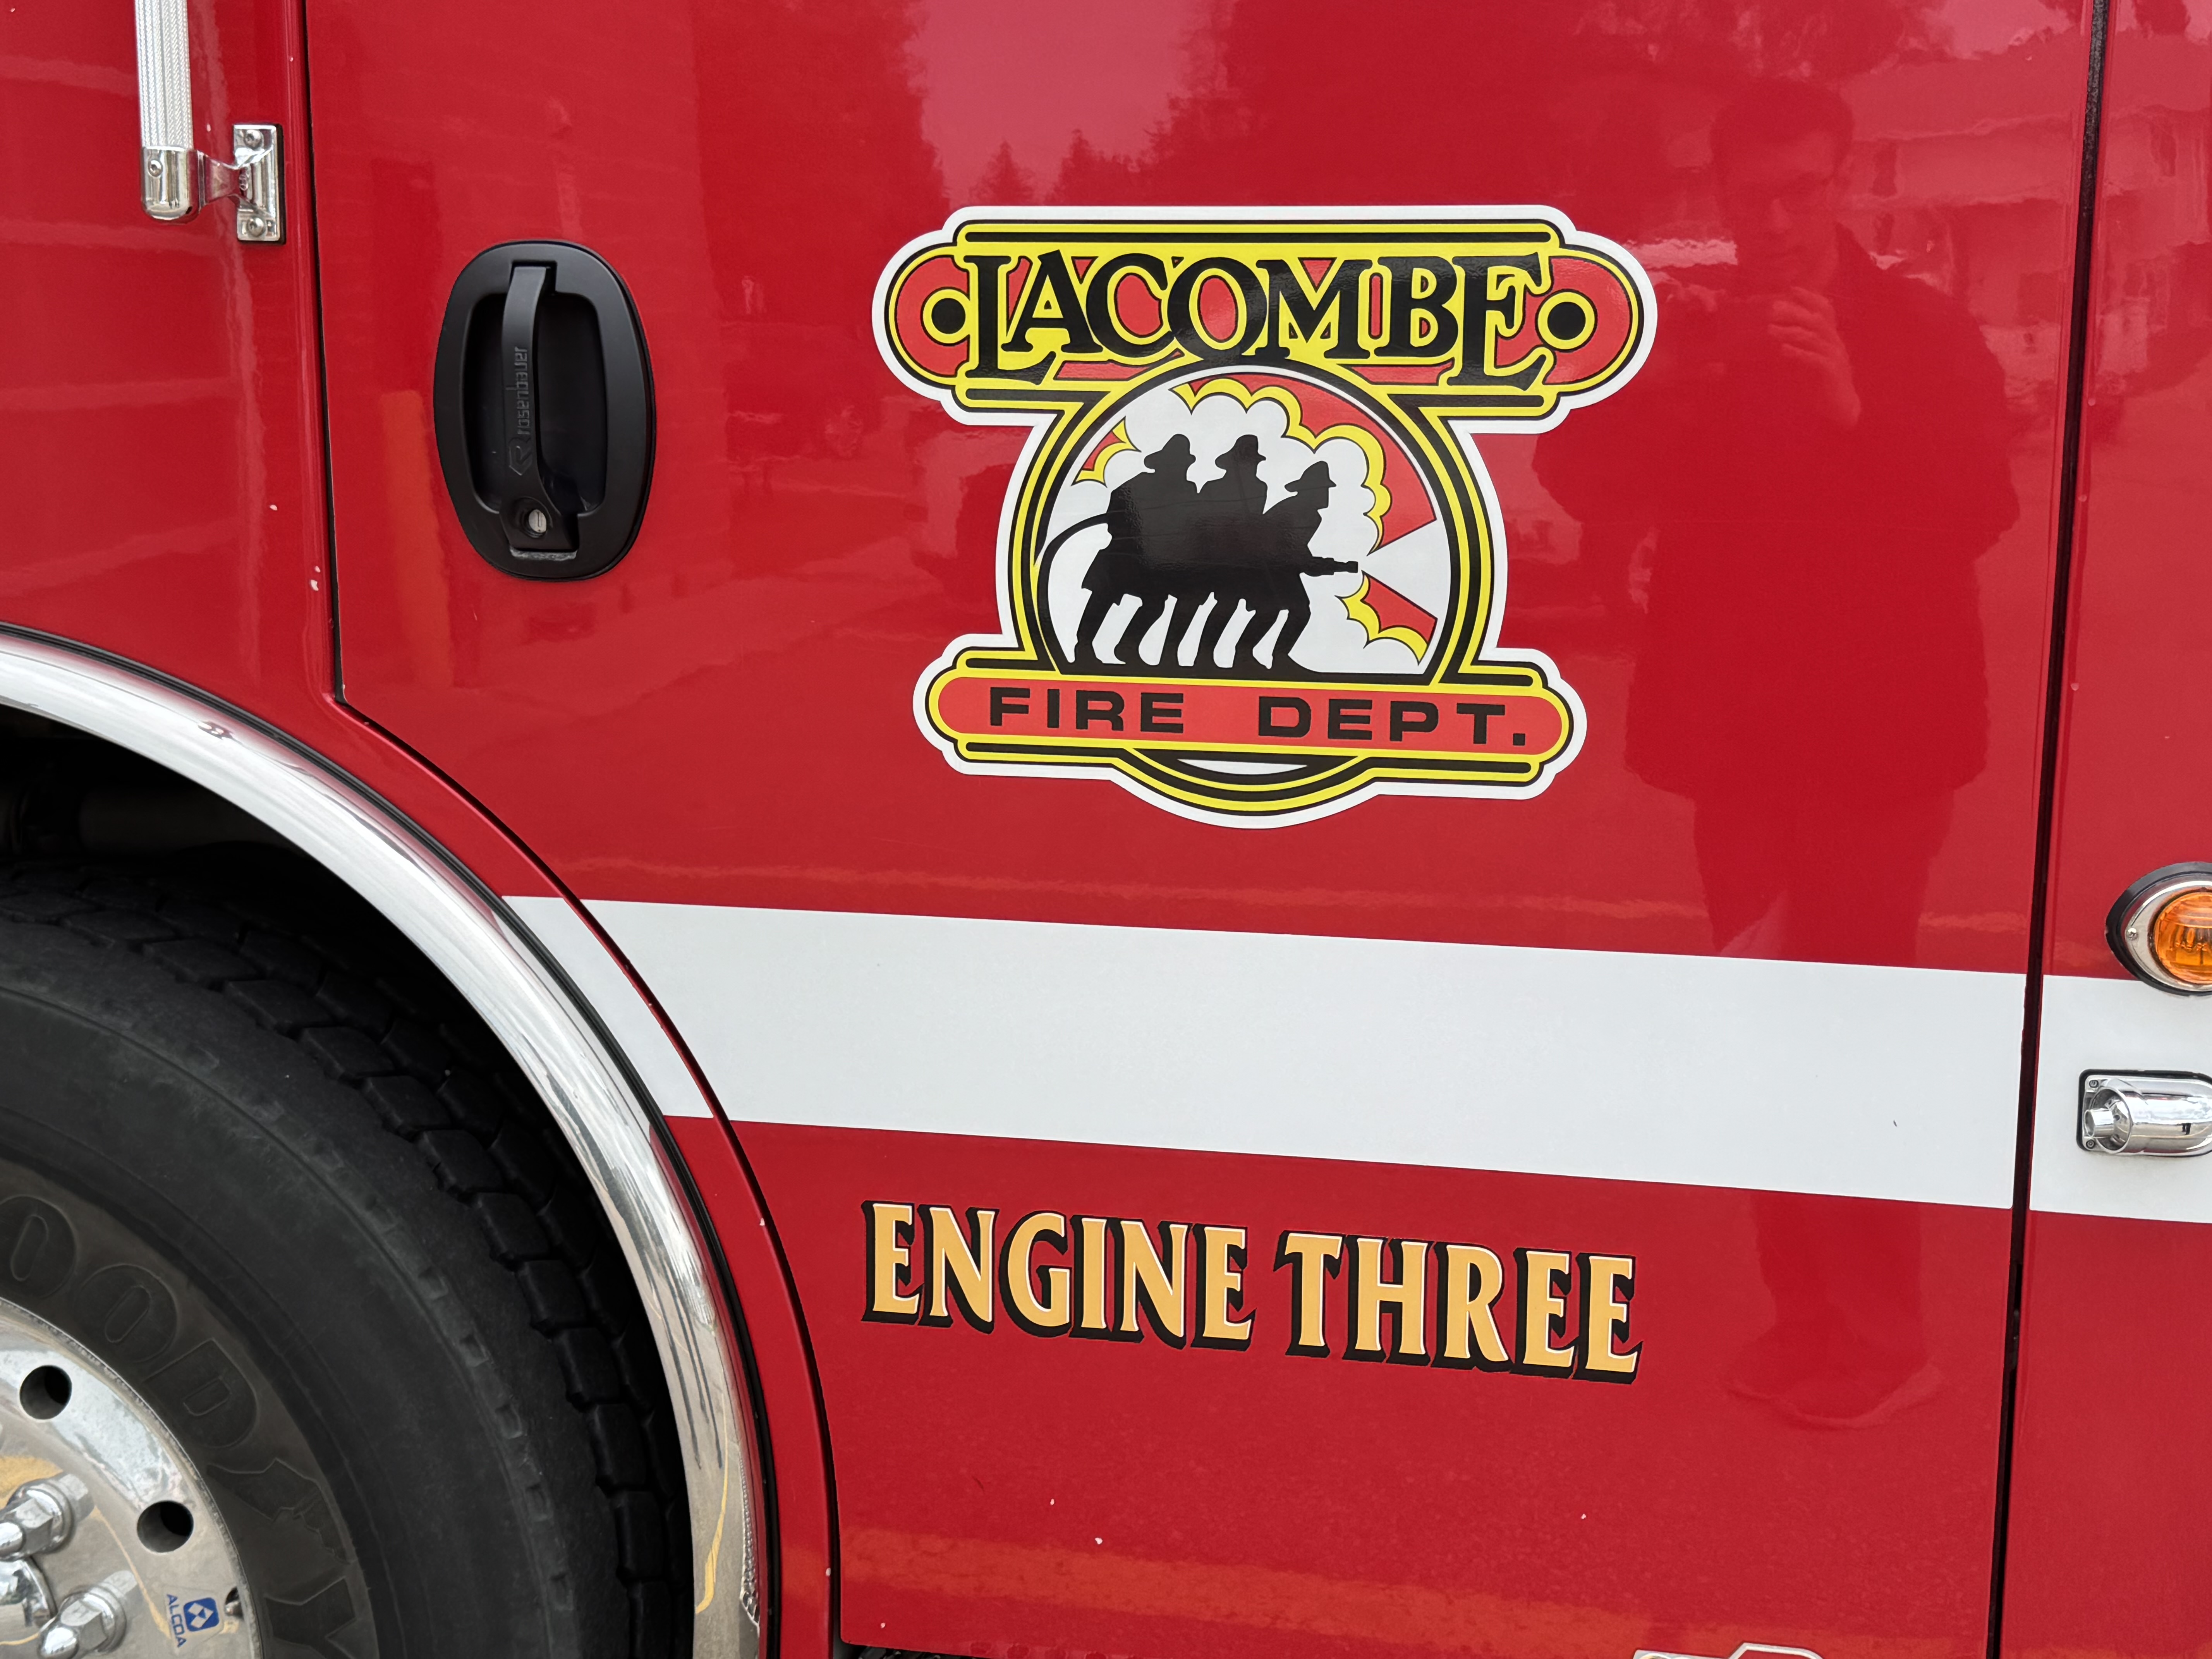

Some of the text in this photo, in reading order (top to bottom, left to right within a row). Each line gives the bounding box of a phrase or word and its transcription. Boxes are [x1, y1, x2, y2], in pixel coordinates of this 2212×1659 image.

[965, 250, 1548, 391] LACOMBE
[506, 346, 531, 436] rosenbauer
[990, 687, 1526, 747] FIRE DEPT.
[861, 1200, 1644, 1384] ENGINE THREE
[166, 1593, 187, 1649] ALCOA
